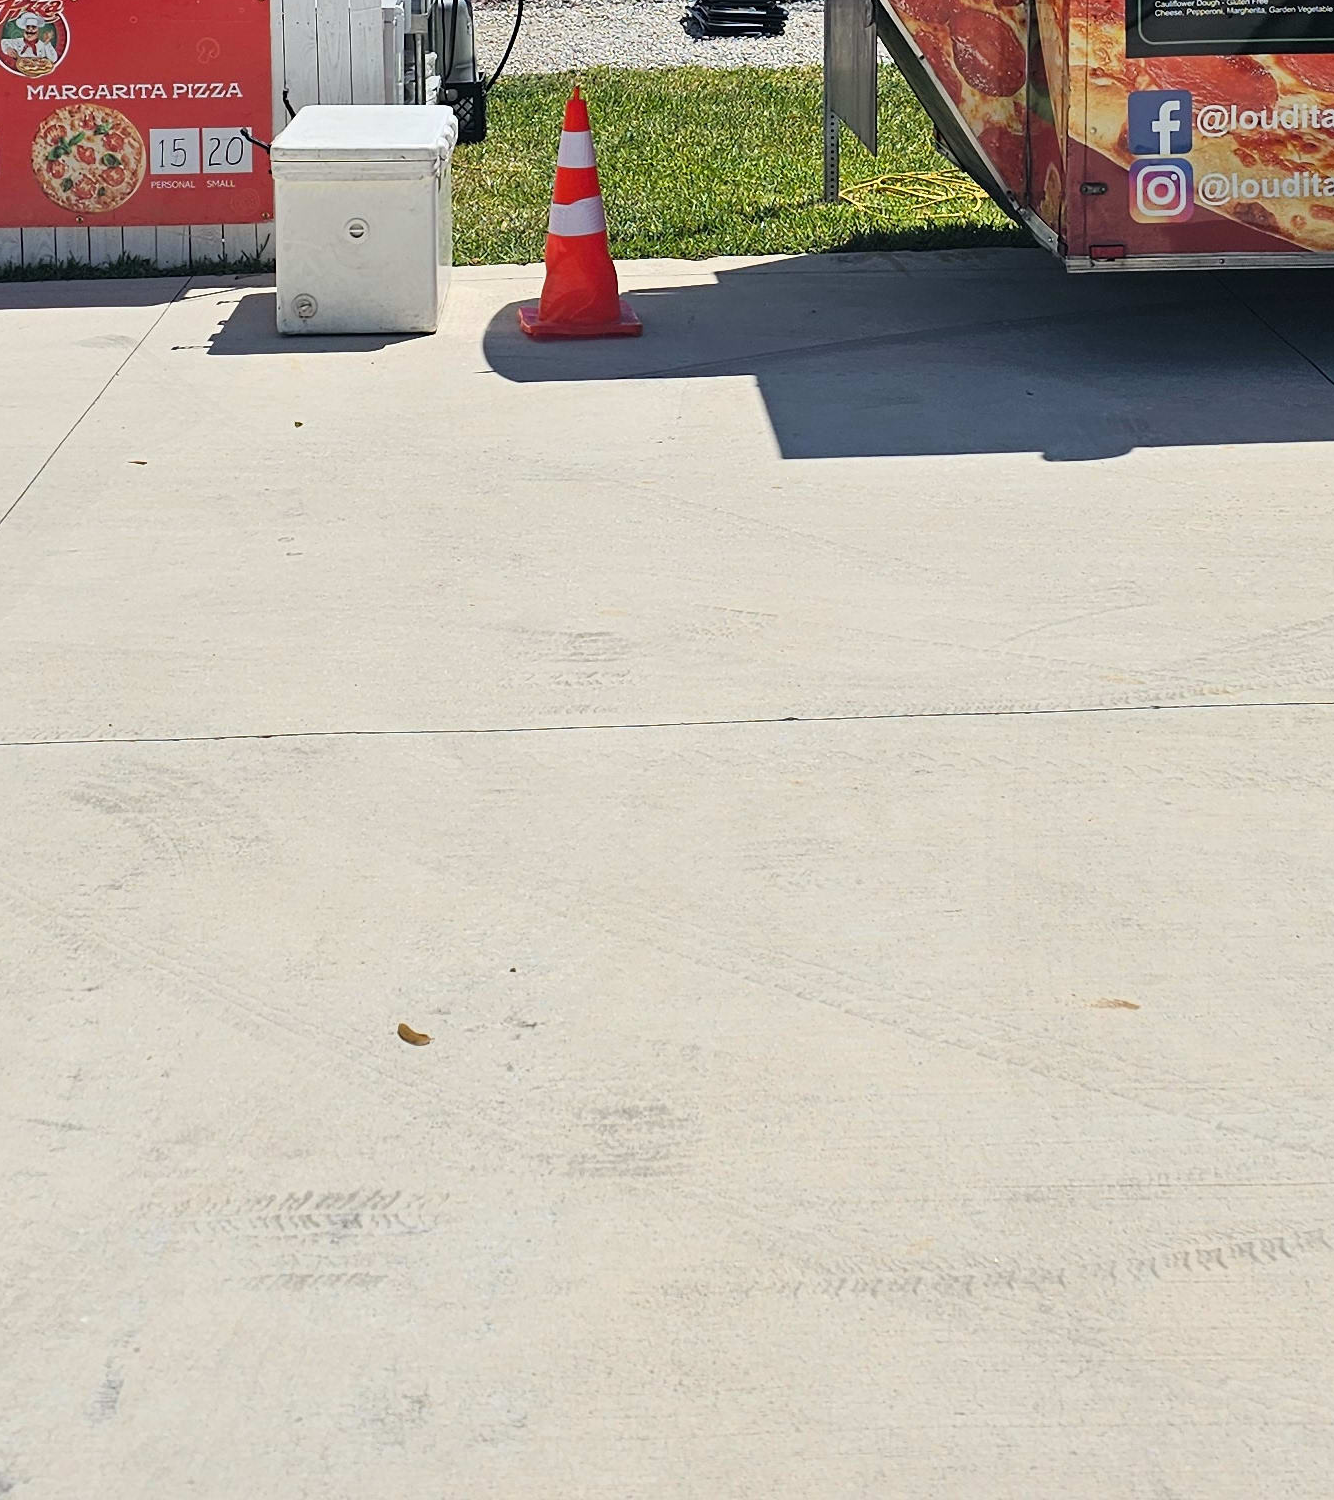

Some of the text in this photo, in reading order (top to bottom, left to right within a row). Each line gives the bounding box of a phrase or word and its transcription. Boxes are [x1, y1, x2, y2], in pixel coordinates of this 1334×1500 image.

[27, 83, 243, 100] MARGARITA PIZZA
[159, 137, 244, 168] 15 20
